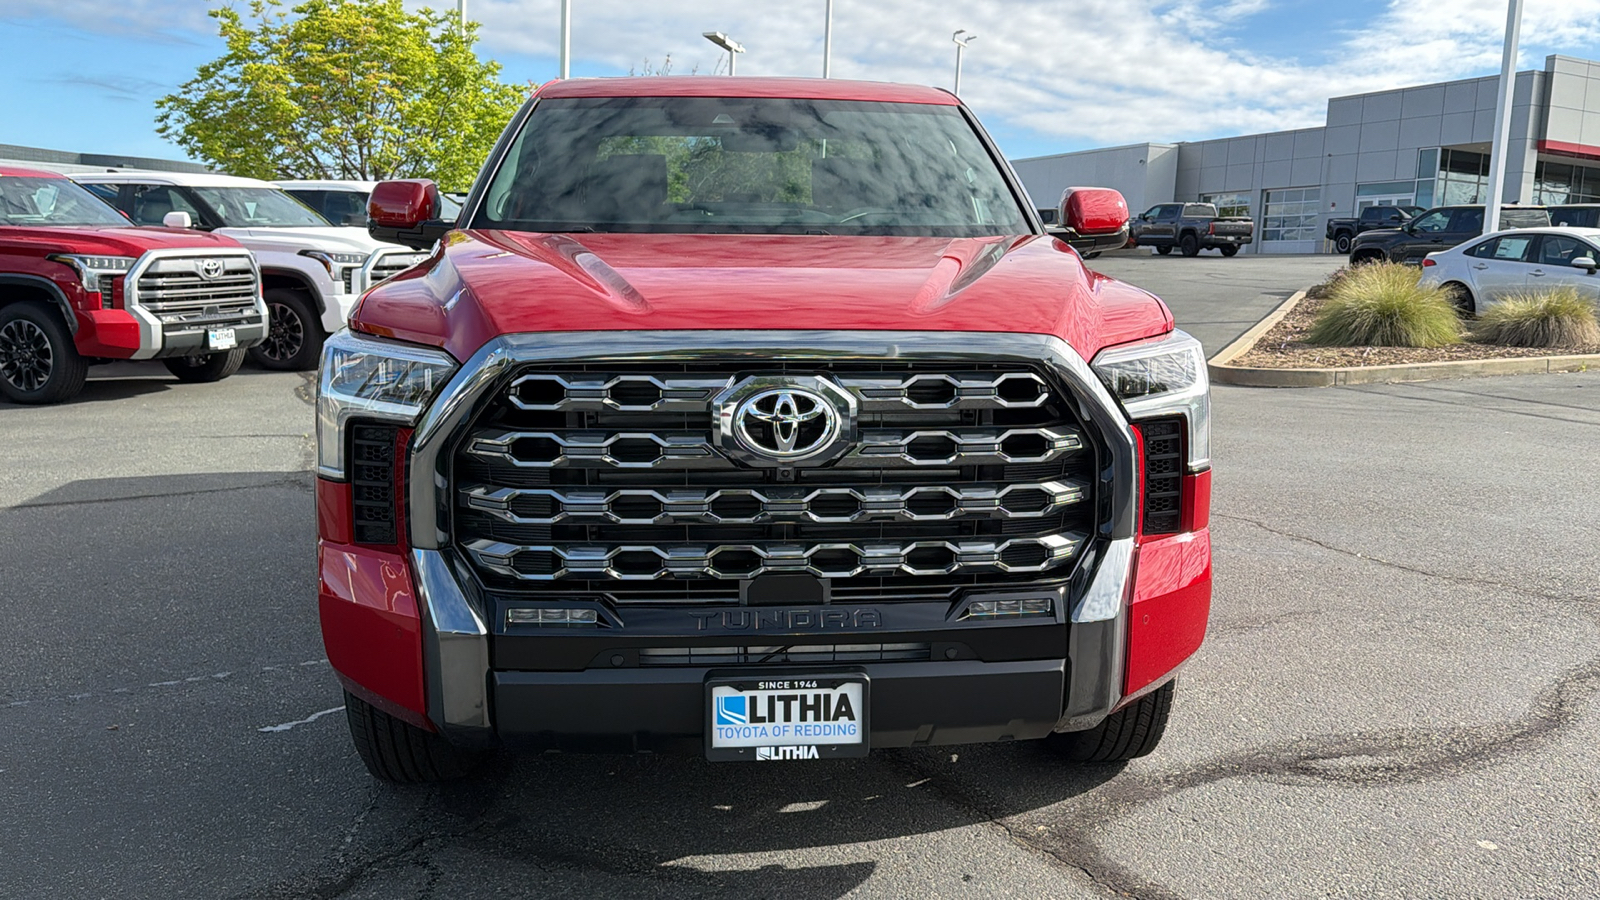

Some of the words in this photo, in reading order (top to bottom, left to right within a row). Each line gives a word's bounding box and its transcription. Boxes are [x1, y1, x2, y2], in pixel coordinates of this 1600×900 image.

[688, 609, 882, 631] TUNDRA
[758, 681, 790, 690] SINCE
[794, 680, 818, 689] 1946
[749, 693, 856, 724] LITHIA
[716, 726, 768, 739] TOYOTA
[772, 725, 790, 737] OF
[794, 724, 857, 737] REDDING
[770, 745, 820, 760] LITHIA
